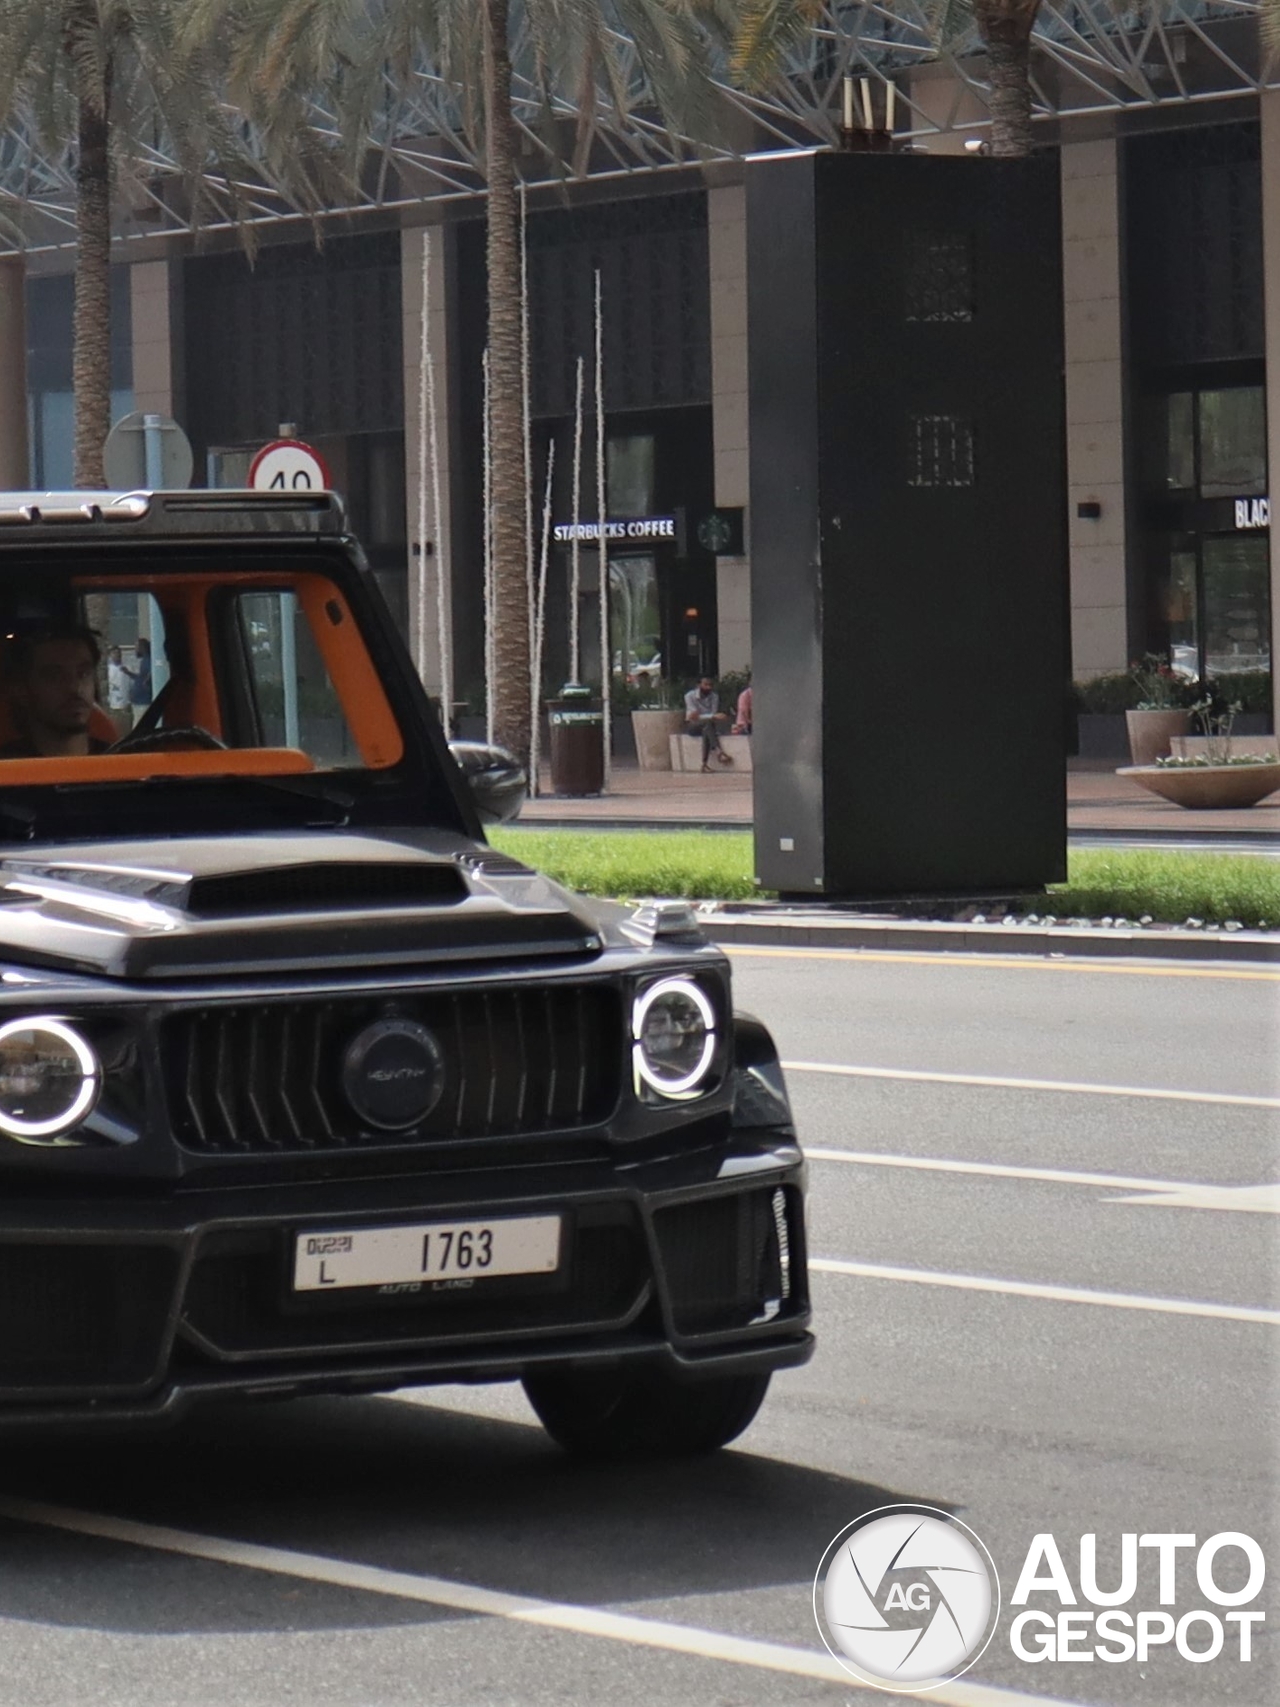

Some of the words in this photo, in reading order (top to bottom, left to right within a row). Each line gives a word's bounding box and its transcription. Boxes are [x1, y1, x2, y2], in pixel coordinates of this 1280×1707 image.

[1235, 498, 1271, 528] BLAC
[554, 523, 625, 541] STARBUCKS
[627, 520, 674, 536] COFFEE
[421, 1229, 493, 1273] 1763
[319, 1260, 336, 1284] L
